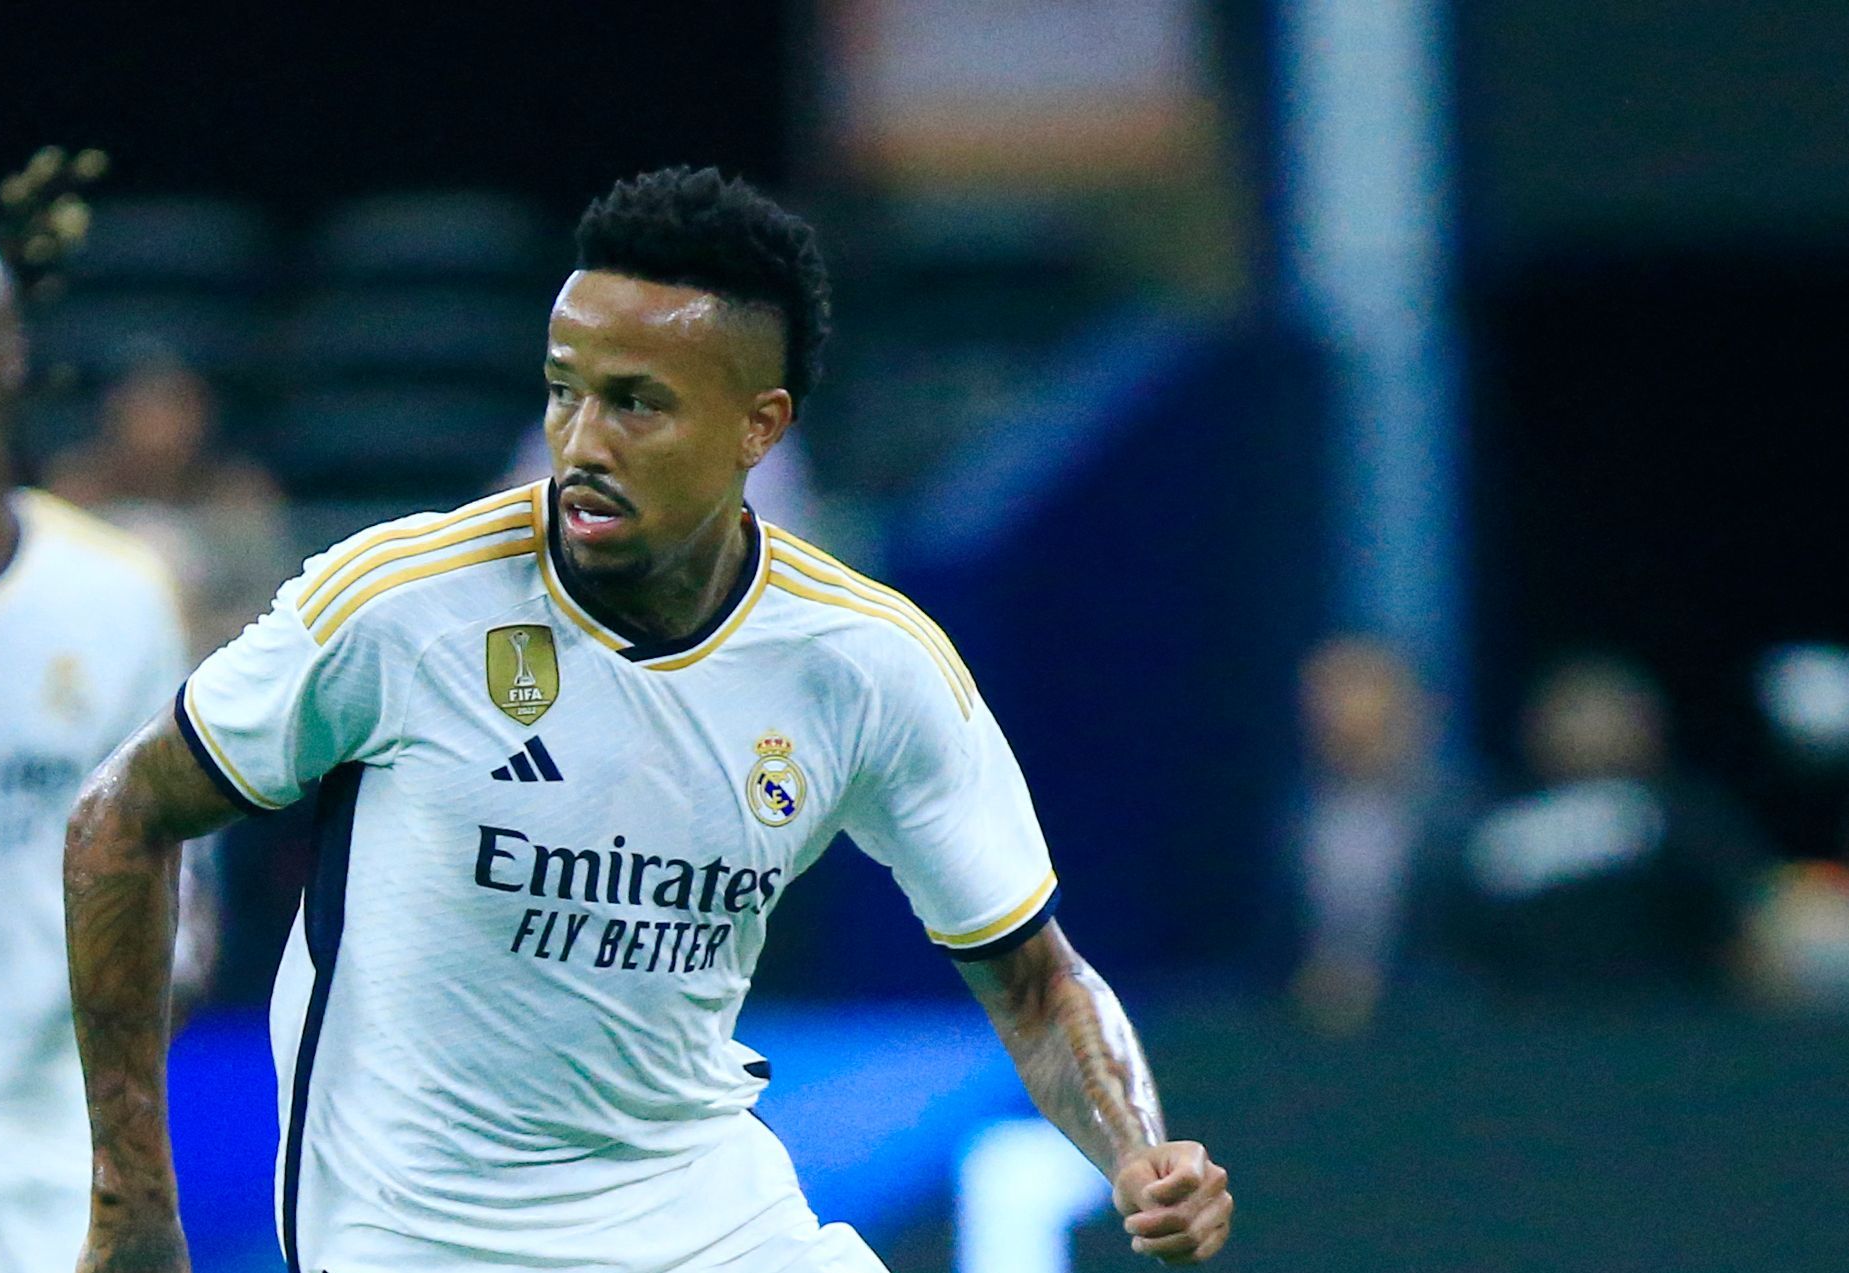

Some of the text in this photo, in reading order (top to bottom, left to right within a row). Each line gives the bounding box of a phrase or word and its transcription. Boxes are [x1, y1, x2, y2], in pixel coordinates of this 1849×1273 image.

[508, 688, 543, 702] FIFA
[474, 824, 782, 915] Emirates
[510, 908, 732, 974] FLY BETTER
